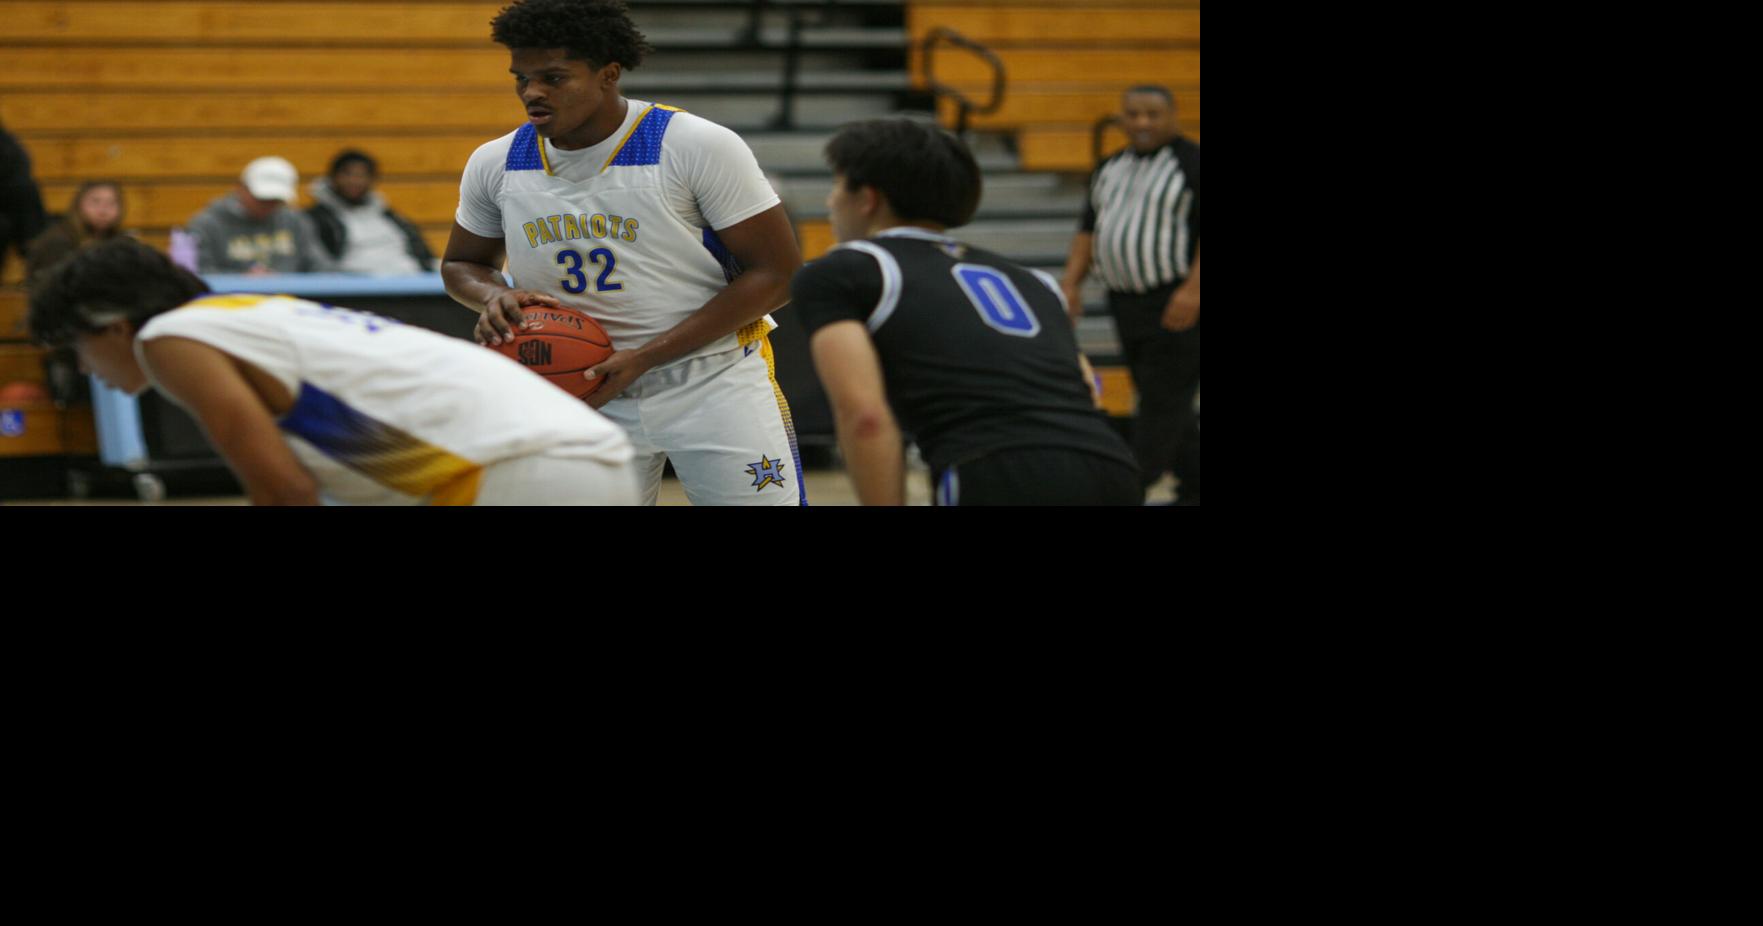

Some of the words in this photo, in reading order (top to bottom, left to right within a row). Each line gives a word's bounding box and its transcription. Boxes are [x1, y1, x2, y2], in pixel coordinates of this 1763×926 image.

[522, 213, 640, 248] PATRIOTS
[555, 246, 625, 294] 32
[951, 262, 1041, 338] 0
